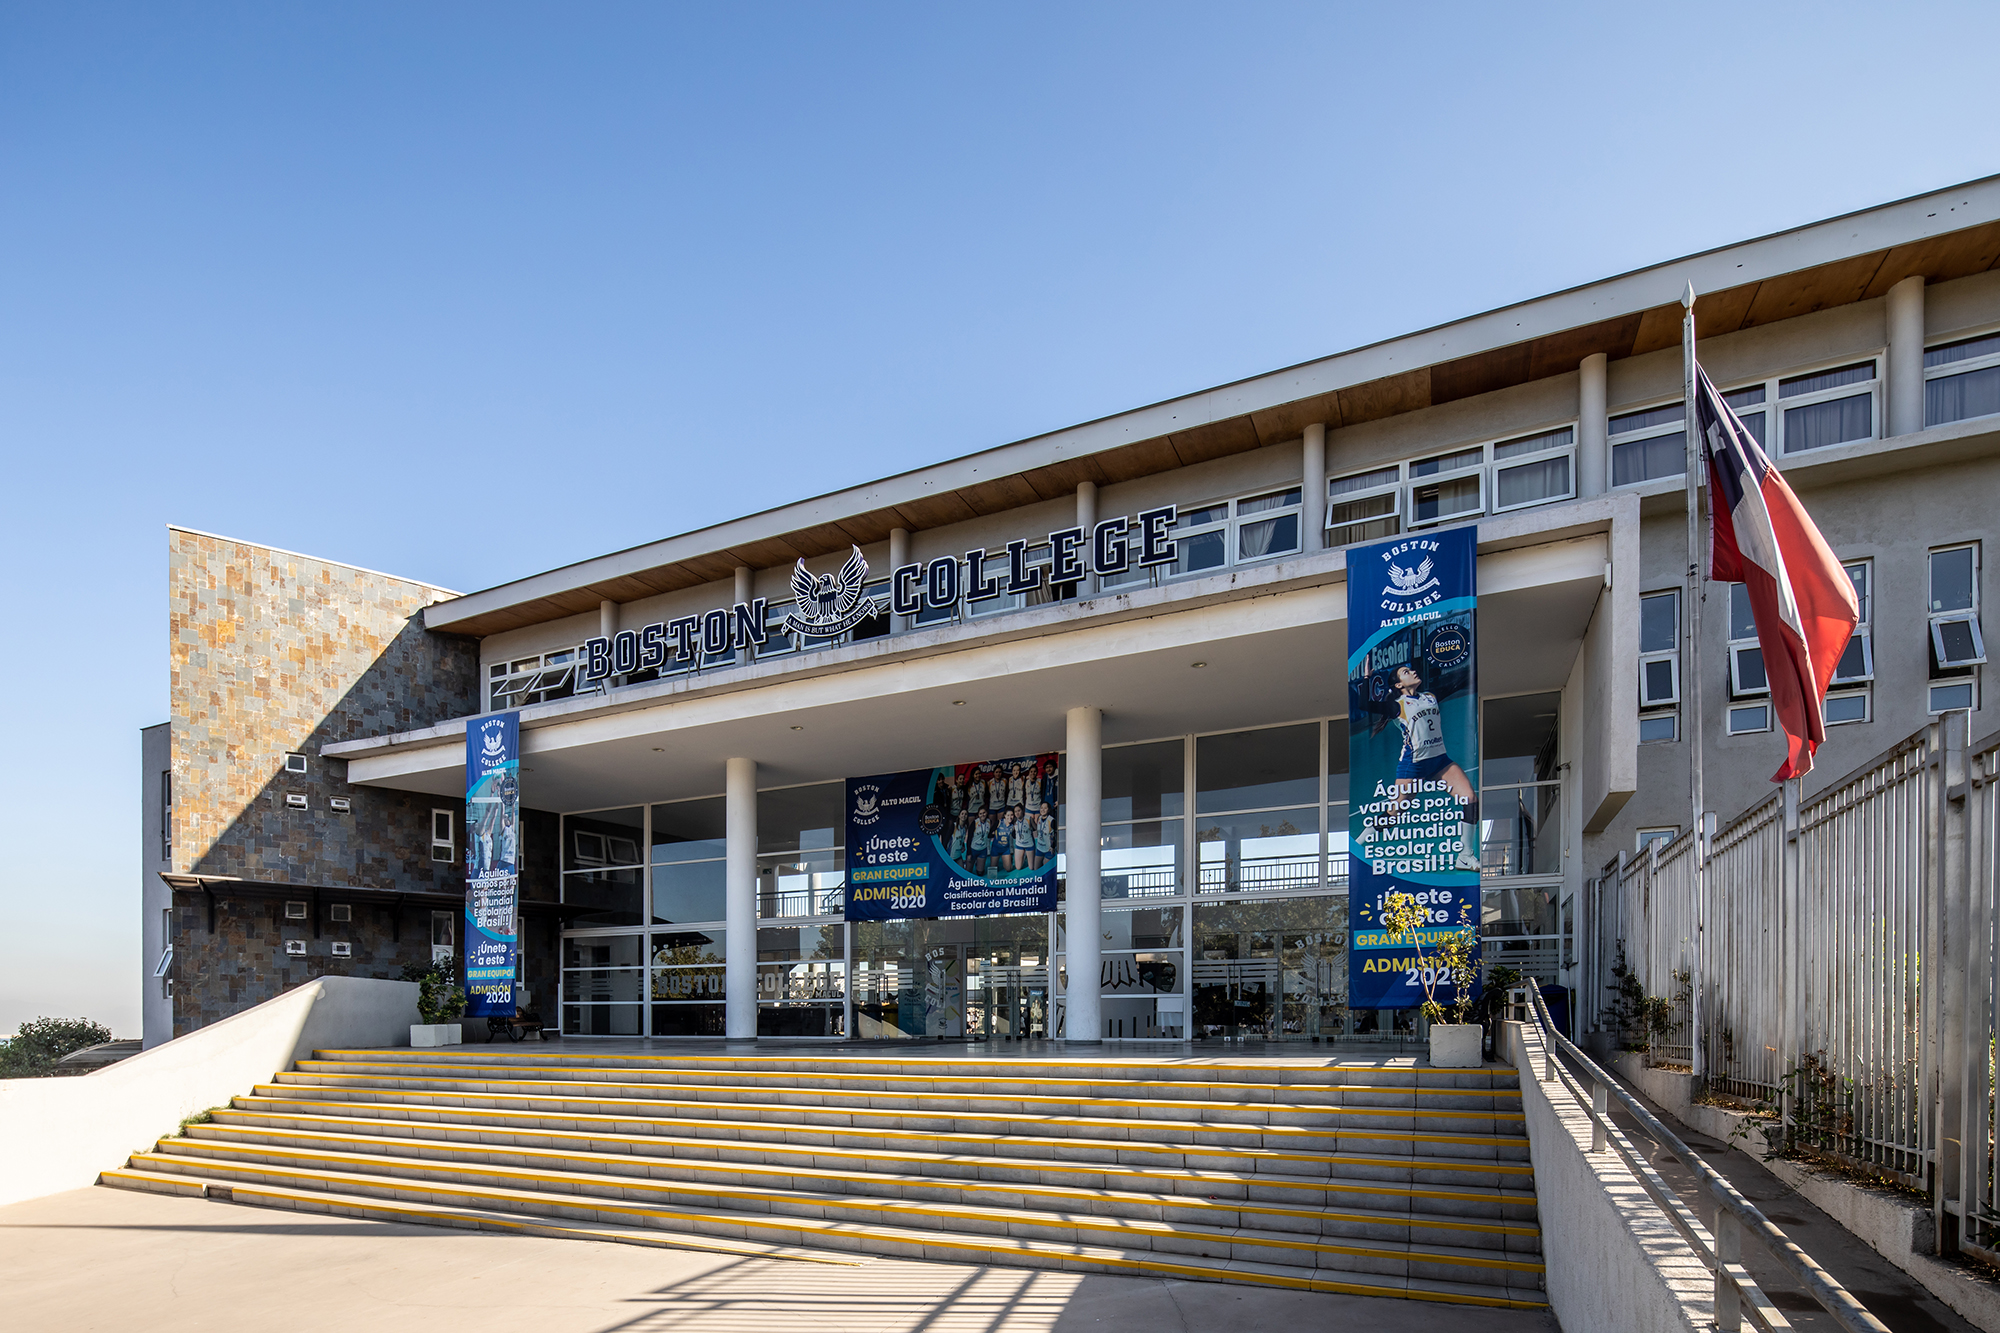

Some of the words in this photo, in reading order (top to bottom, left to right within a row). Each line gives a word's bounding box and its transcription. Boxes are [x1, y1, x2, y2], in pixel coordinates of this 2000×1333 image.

[1381, 540, 1440, 562] BOSTON
[585, 597, 768, 681] BOSTON
[892, 504, 1178, 616] COLLEGE
[1380, 590, 1442, 613] COLLEGE
[793, 620, 804, 631] MAN
[804, 624, 811, 633] IS
[811, 626, 824, 634] BUT
[824, 624, 842, 633] WHAT
[842, 617, 853, 627] HE
[852, 602, 873, 623] KNOWS
[1380, 616, 1405, 628] ALTO
[1407, 611, 1442, 624] MACUL
[1436, 625, 1459, 634] SELLO
[1435, 638, 1461, 648] Boston
[1435, 644, 1461, 654] EDUCA
[1372, 640, 1409, 671] Escolar
[1427, 656, 1435, 664] DE
[1438, 651, 1468, 668] CALIDAD
[481, 719, 505, 732] BOSTON
[1427, 718, 1435, 731] 2
[481, 755, 507, 767] COLLEGE
[482, 768, 492, 777] ALTO
[493, 767, 507, 776] MACUL
[853, 784, 880, 796] BOSTON
[1373, 778, 1453, 800] Águilas,
[881, 798, 898, 807] ALTO
[899, 795, 921, 805] MACUL
[1359, 800, 1421, 815] vamos
[1424, 797, 1451, 812] por
[1454, 794, 1469, 806] la
[852, 814, 880, 826] COLLEGE
[1363, 809, 1465, 828] Clasificación
[1365, 829, 1379, 843] al
[1382, 821, 1463, 841] Mundial
[866, 834, 911, 853] ¡Únete
[1364, 842, 1434, 859] Escolar
[1438, 838, 1464, 853] de
[867, 853, 876, 864] a
[878, 850, 908, 863] este
[1372, 854, 1455, 876] Brasil!!
[478, 868, 511, 880] Águilas,
[853, 870, 882, 881] GRAN
[883, 866, 927, 879] EQUIPO!
[472, 879, 498, 889] vamos
[498, 879, 509, 891] por
[509, 878, 517, 887] la
[948, 877, 988, 890] Águilas,
[989, 878, 1018, 886] vamos
[1019, 877, 1033, 886] por
[1034, 875, 1042, 883] la
[473, 887, 514, 898] Clasificación
[853, 881, 926, 901] ADMISIÓN
[943, 888, 994, 900] Clasificación
[995, 889, 1004, 897] al
[1005, 884, 1047, 896] Mundial
[474, 898, 481, 907] al
[481, 896, 513, 907] Mundial
[890, 895, 926, 910] 2020
[950, 899, 986, 911] Escolar
[987, 899, 1000, 909] de
[1002, 897, 1039, 908] Brasil!!
[474, 906, 503, 918] Escolar
[503, 904, 513, 915] de
[477, 915, 509, 928] Brasil!!
[1356, 933, 1402, 946] GRAN
[477, 941, 507, 957] ¡Únete
[478, 957, 484, 966] a
[485, 954, 505, 965] este
[467, 969, 487, 979] GRAN
[487, 967, 514, 978] EQUIPO!
[470, 982, 511, 996] ADMISIÓN
[816, 990, 842, 998] MACUL
[486, 991, 511, 1004] 2020
[1294, 988, 1348, 1006] COLLEG
